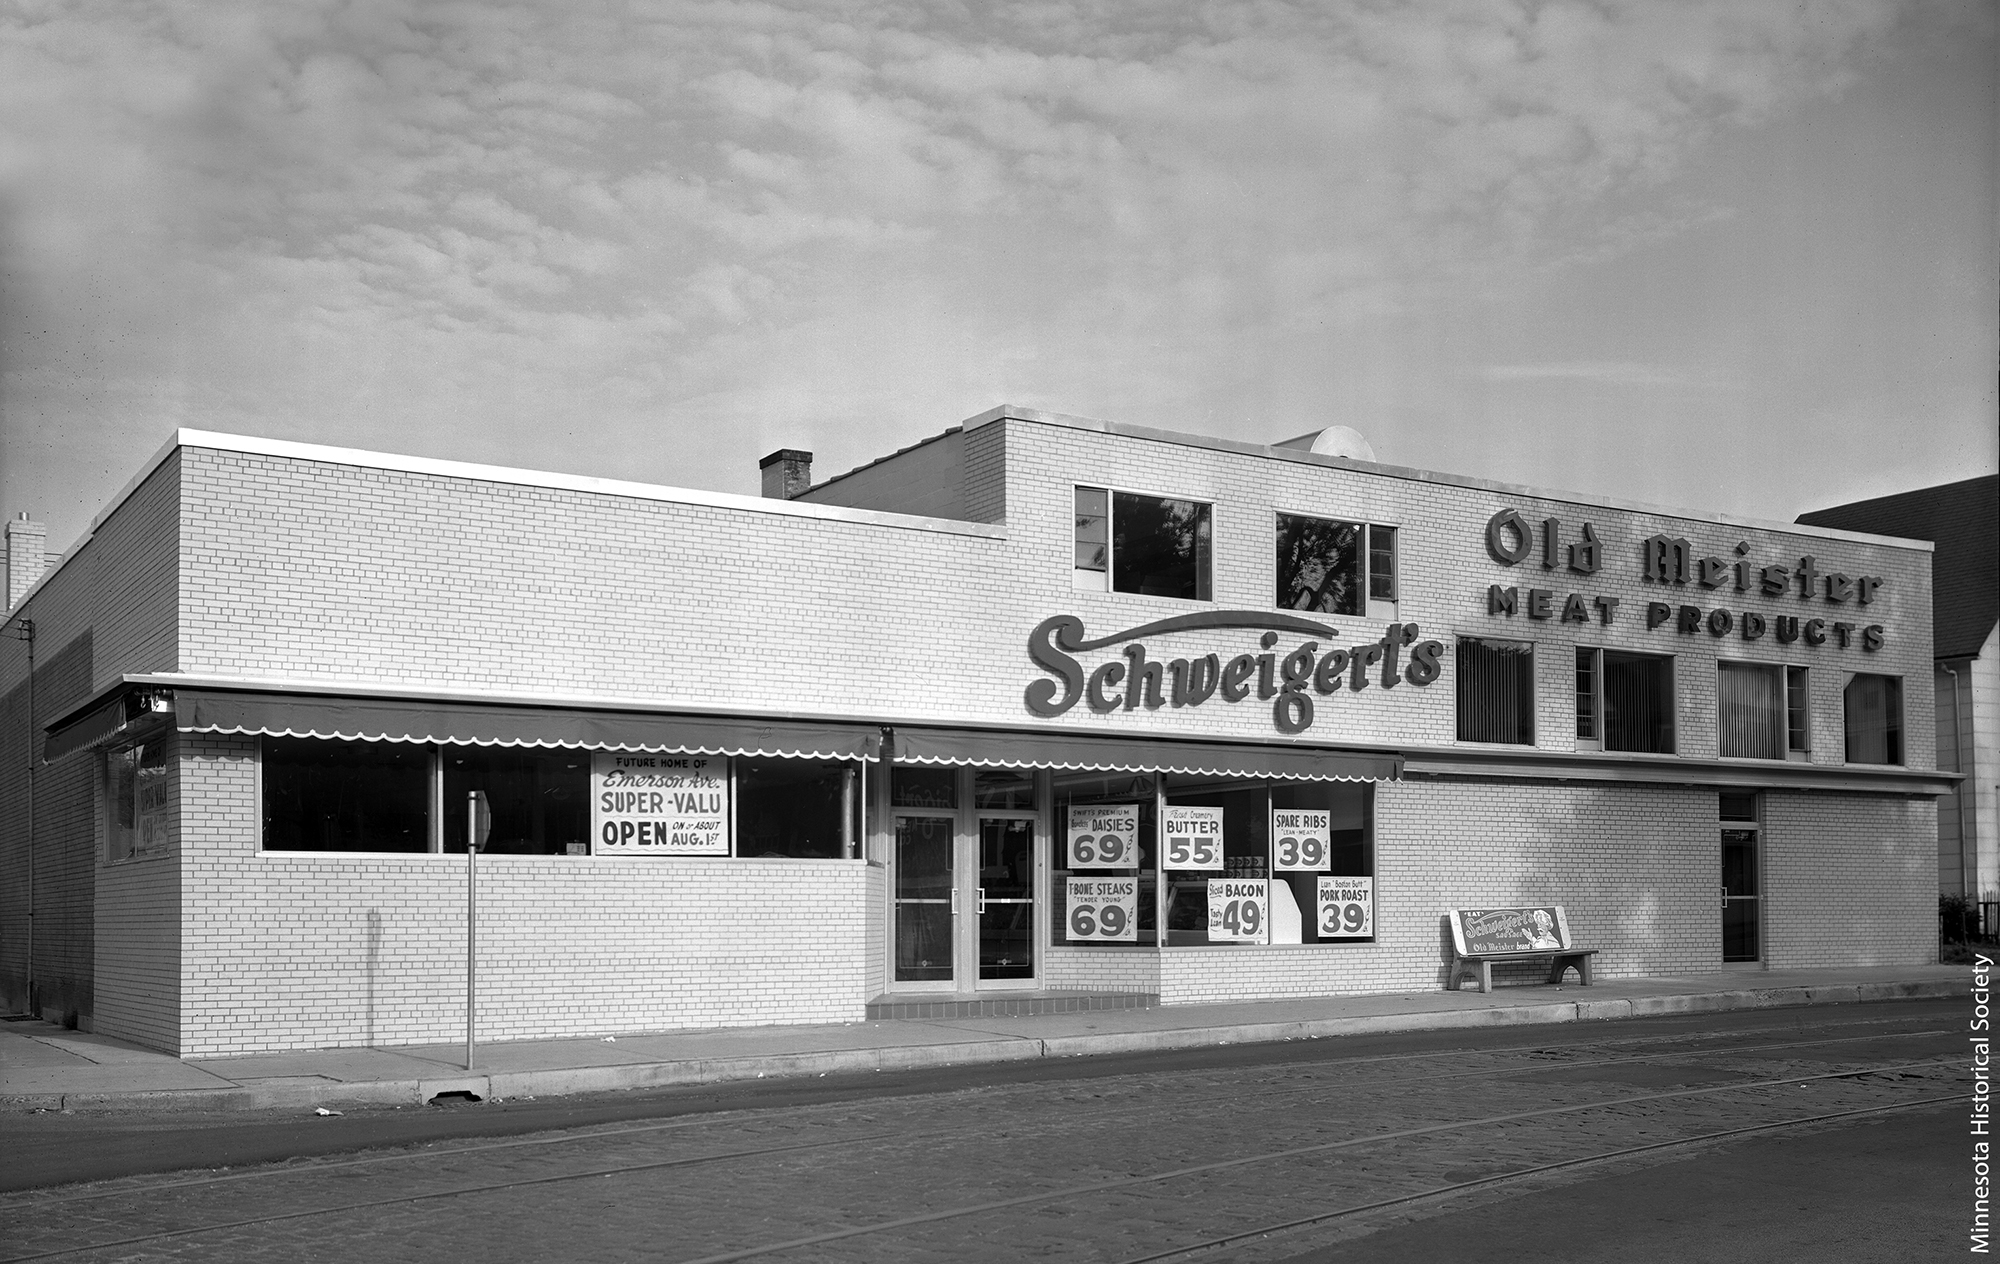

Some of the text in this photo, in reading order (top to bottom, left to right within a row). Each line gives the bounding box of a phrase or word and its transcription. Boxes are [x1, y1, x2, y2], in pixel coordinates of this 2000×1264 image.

[1487, 508, 1884, 605] Old Meister
[1490, 585, 1884, 651] MEAT PRODUCTS
[1024, 611, 1443, 733] Schweigert's
[615, 757, 708, 769] FUTURE HOME OF
[602, 769, 721, 789] Emerson Ave.
[1073, 809, 1096, 817] SWIFT'S
[1276, 814, 1327, 828] SPARE RIBS
[602, 821, 667, 846] OPEN
[672, 821, 685, 830] ON
[693, 821, 721, 830] ABOUT
[1092, 818, 1135, 832] DAISIES
[1166, 820, 1219, 834] BUTTER
[671, 832, 704, 846] AUG.
[1073, 834, 1124, 863] 69
[1169, 837, 1214, 864] 55
[1278, 837, 1323, 866] 39
[1068, 882, 1133, 896] T-BONE STEAKS
[1225, 884, 1264, 898] BACON
[1320, 889, 1369, 901] PORK ROAST
[1070, 904, 1127, 936] 69
[1223, 900, 1260, 936] 49
[1322, 903, 1364, 933] 39
[1465, 909, 1534, 939] Schweigert's
[1473, 941, 1530, 952] Old Meister brand
